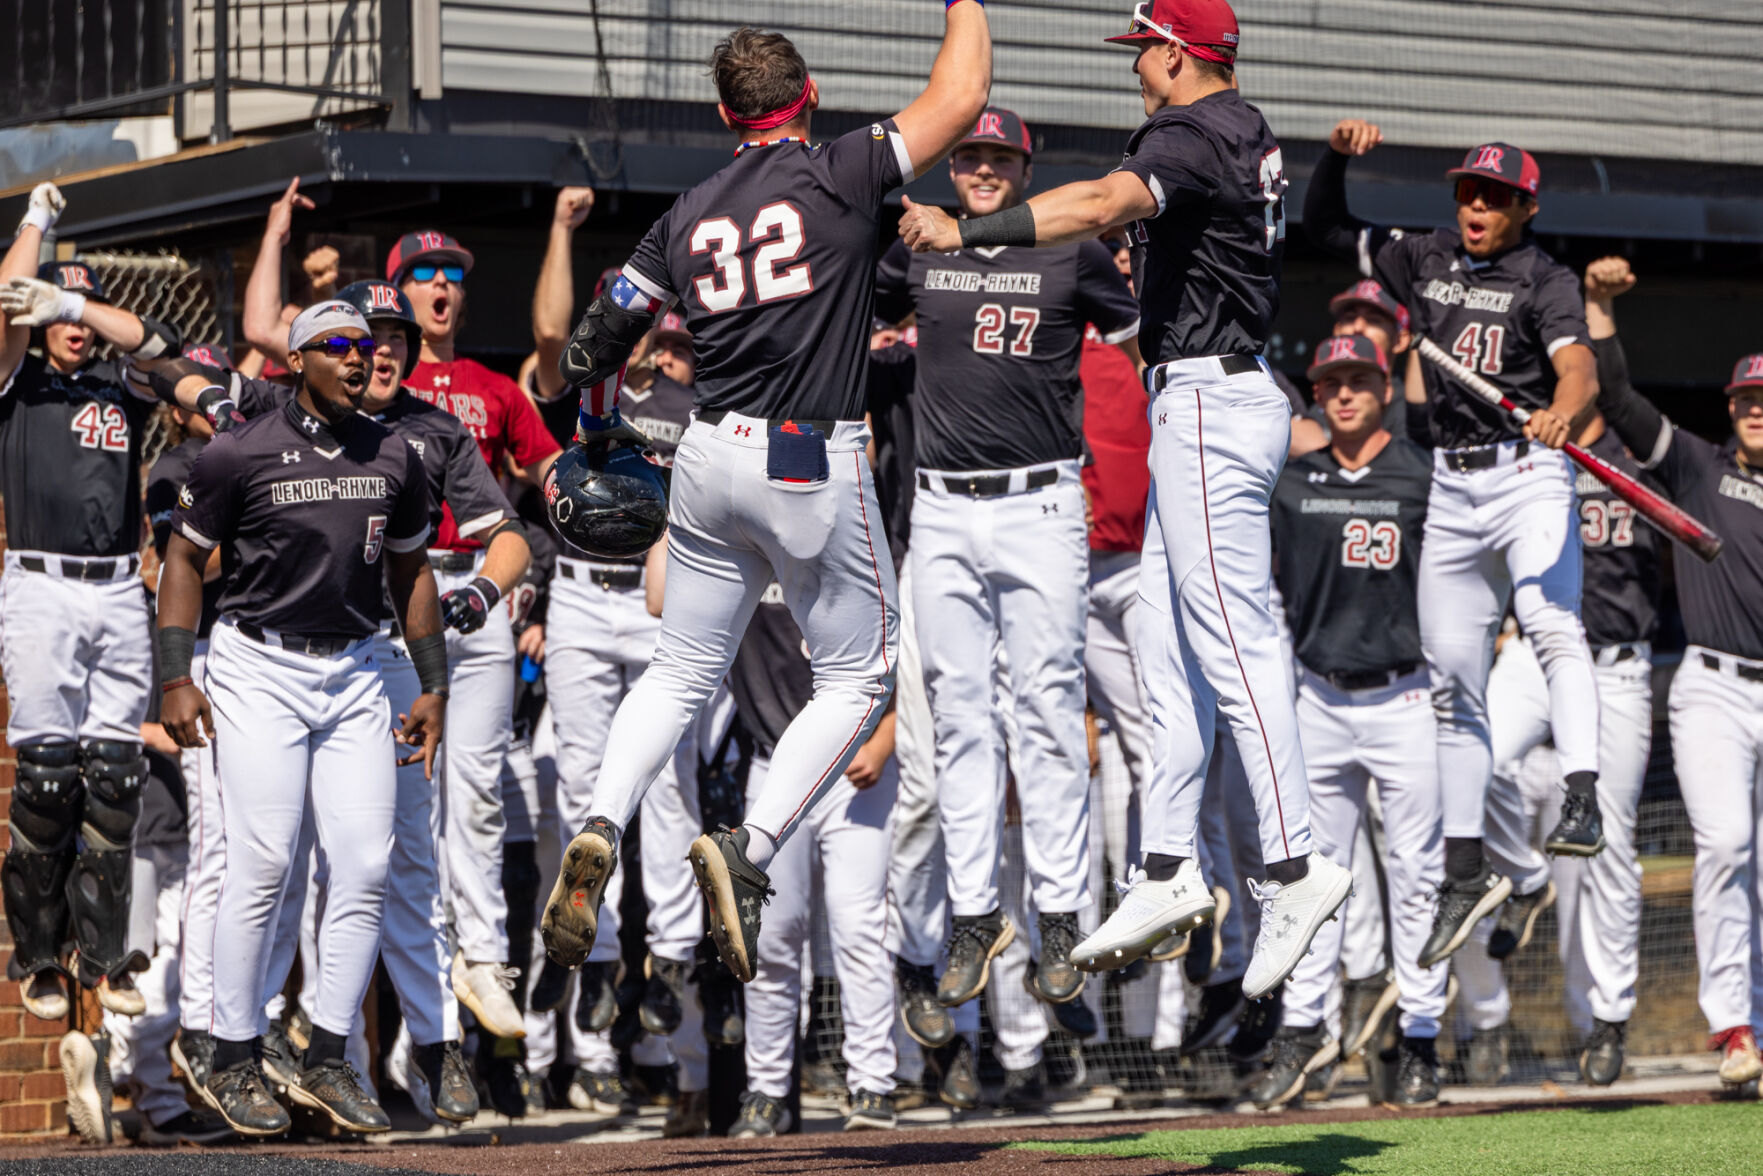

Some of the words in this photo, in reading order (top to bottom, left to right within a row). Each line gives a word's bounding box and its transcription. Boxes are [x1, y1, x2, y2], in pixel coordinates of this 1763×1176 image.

[689, 200, 815, 315] 32
[925, 269, 1042, 295] LENOIR-RHYNE
[973, 303, 1041, 357] 27
[1452, 321, 1505, 376] 41
[71, 401, 129, 453] 42
[271, 476, 387, 506] LENOIR-RHYNE
[363, 515, 388, 565] 5
[1341, 518, 1402, 571] 23
[1580, 499, 1637, 548] 37
